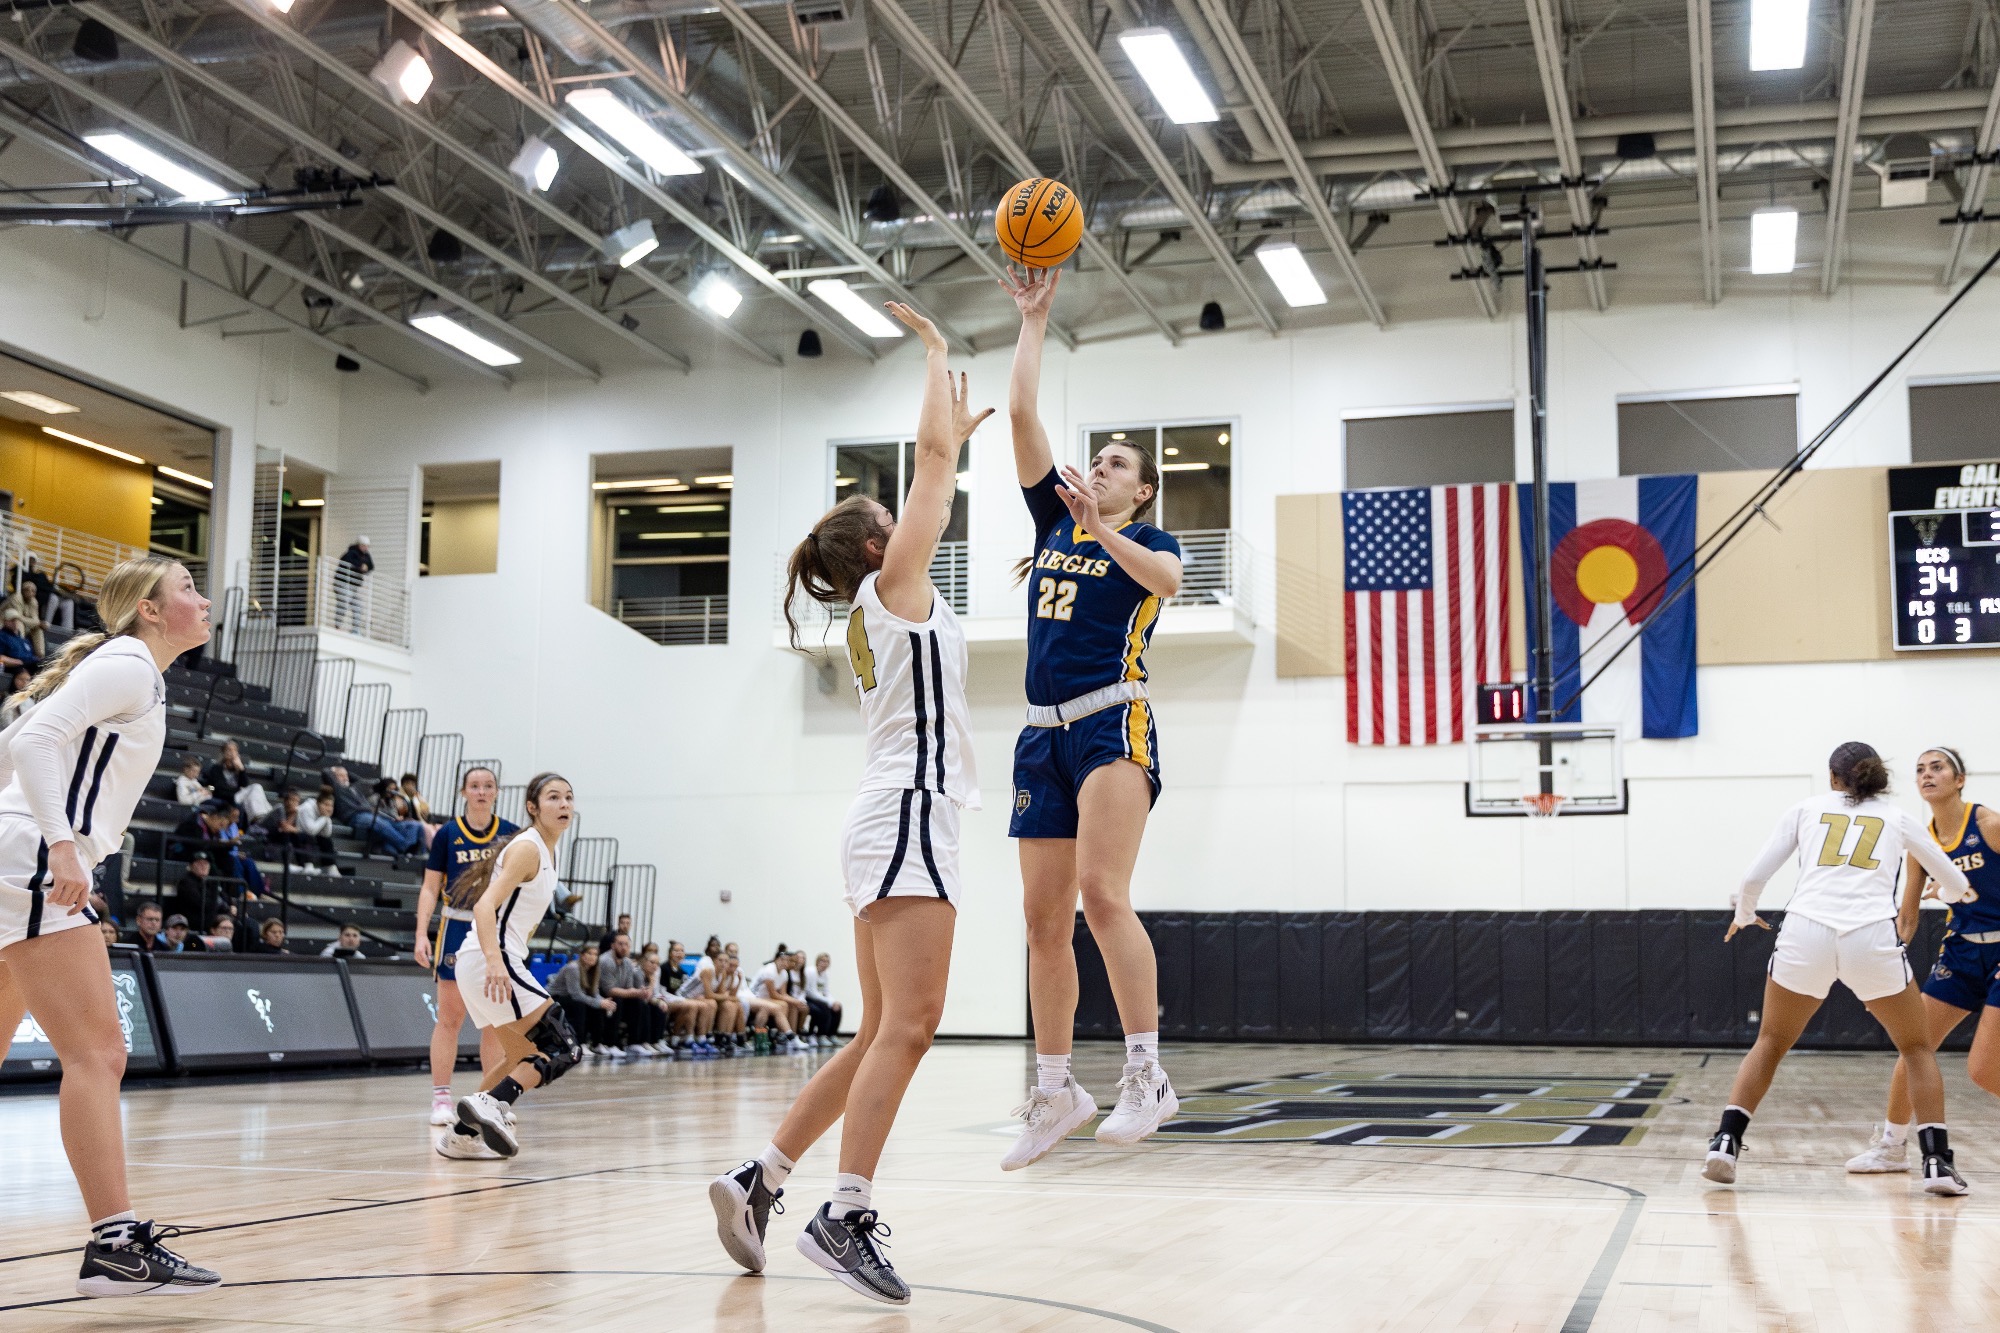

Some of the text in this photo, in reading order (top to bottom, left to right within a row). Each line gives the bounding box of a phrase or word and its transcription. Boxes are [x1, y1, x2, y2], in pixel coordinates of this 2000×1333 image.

[1041, 185, 1068, 222] NCAA
[1959, 463, 2000, 487] GAL
[1035, 549, 1111, 577] REGIS
[1915, 547, 1950, 563] UCCS
[1919, 565, 1958, 595] 34
[1036, 577, 1079, 621] 22
[1908, 600, 1936, 616] FLS
[1918, 617, 1971, 643] 0 3
[847, 605, 877, 694] 4
[1493, 690, 1520, 719] 11
[455, 849, 494, 864] REG
[1952, 852, 1985, 872] GIS
